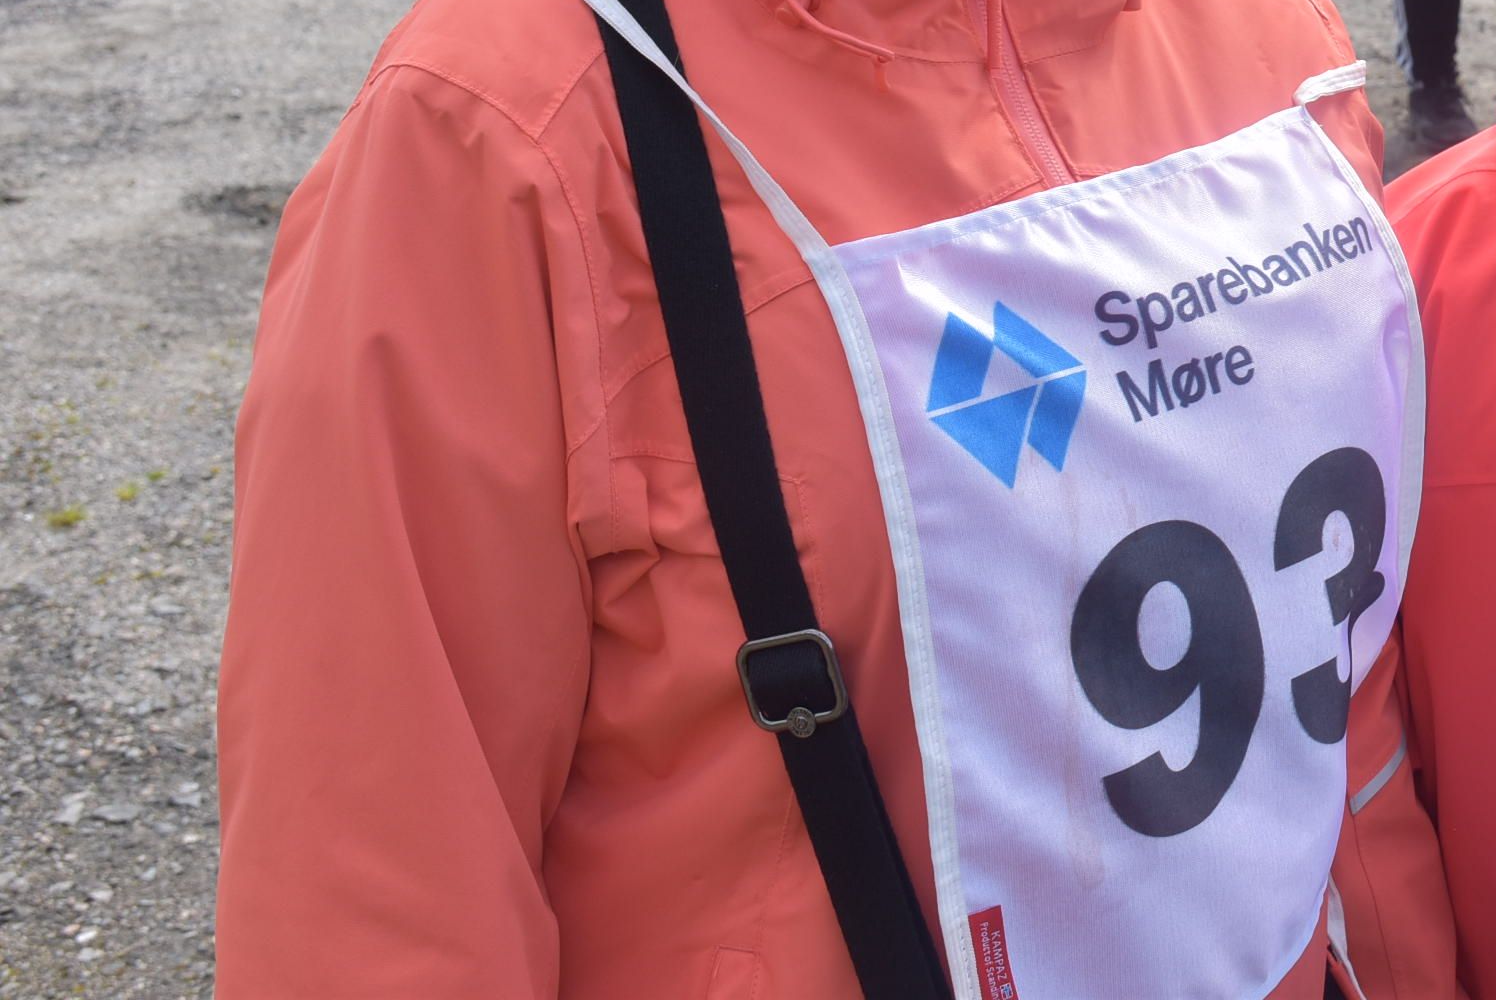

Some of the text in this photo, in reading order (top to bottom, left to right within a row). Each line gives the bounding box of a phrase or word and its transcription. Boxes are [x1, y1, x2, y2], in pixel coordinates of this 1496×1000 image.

[1094, 216, 1373, 350] Sparebanken
[1116, 345, 1255, 423] Møre
[1070, 446, 1386, 838] 93
[980, 921, 991, 956] Product
[991, 930, 1007, 980] KAMPAZ
[985, 967, 1000, 1000] Scandin
